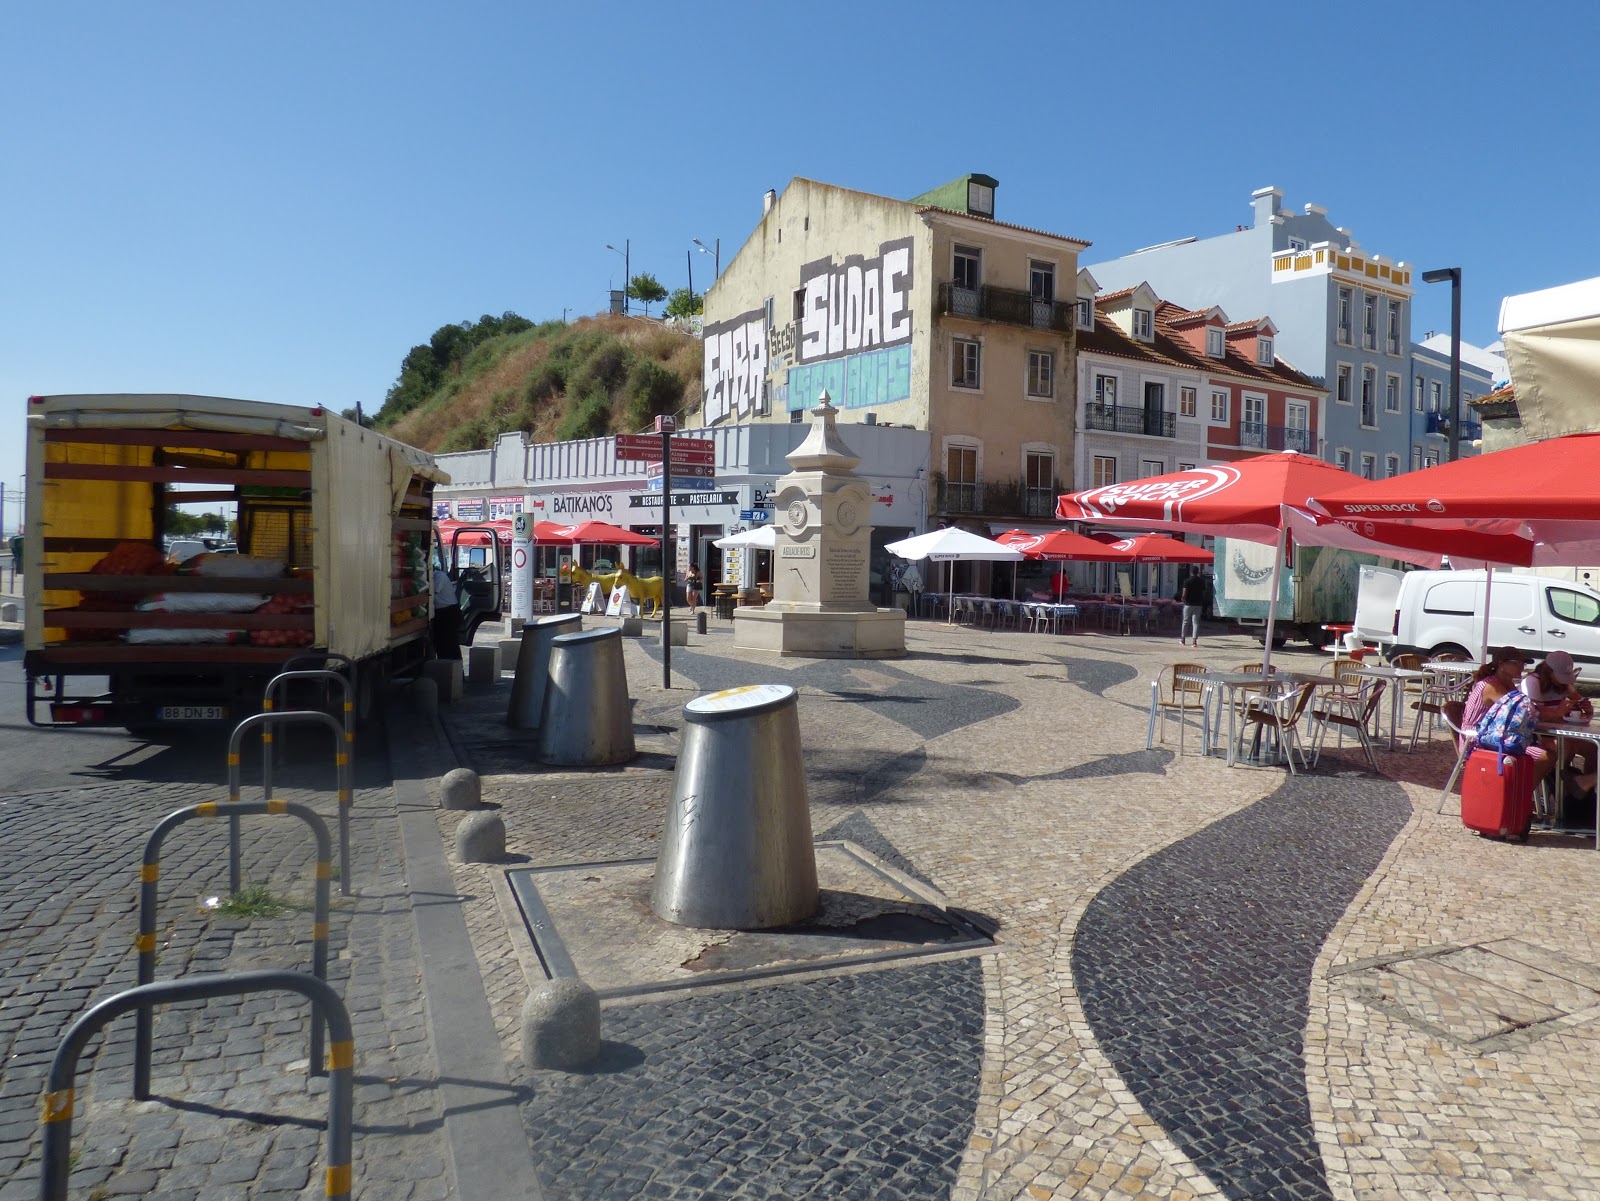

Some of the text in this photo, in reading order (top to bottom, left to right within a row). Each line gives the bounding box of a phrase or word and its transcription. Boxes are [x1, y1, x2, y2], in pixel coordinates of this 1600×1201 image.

[635, 438, 663, 446] Submarino
[1107, 479, 1209, 495] SUPER
[553, 494, 613, 513] BATIKANO'S
[689, 493, 723, 504] PASTELARIA
[1098, 488, 1192, 514] BOCK
[1343, 504, 1381, 513] SUPER
[1381, 503, 1421, 512] BOCK
[164, 707, 221, 718] 88-DN-91
